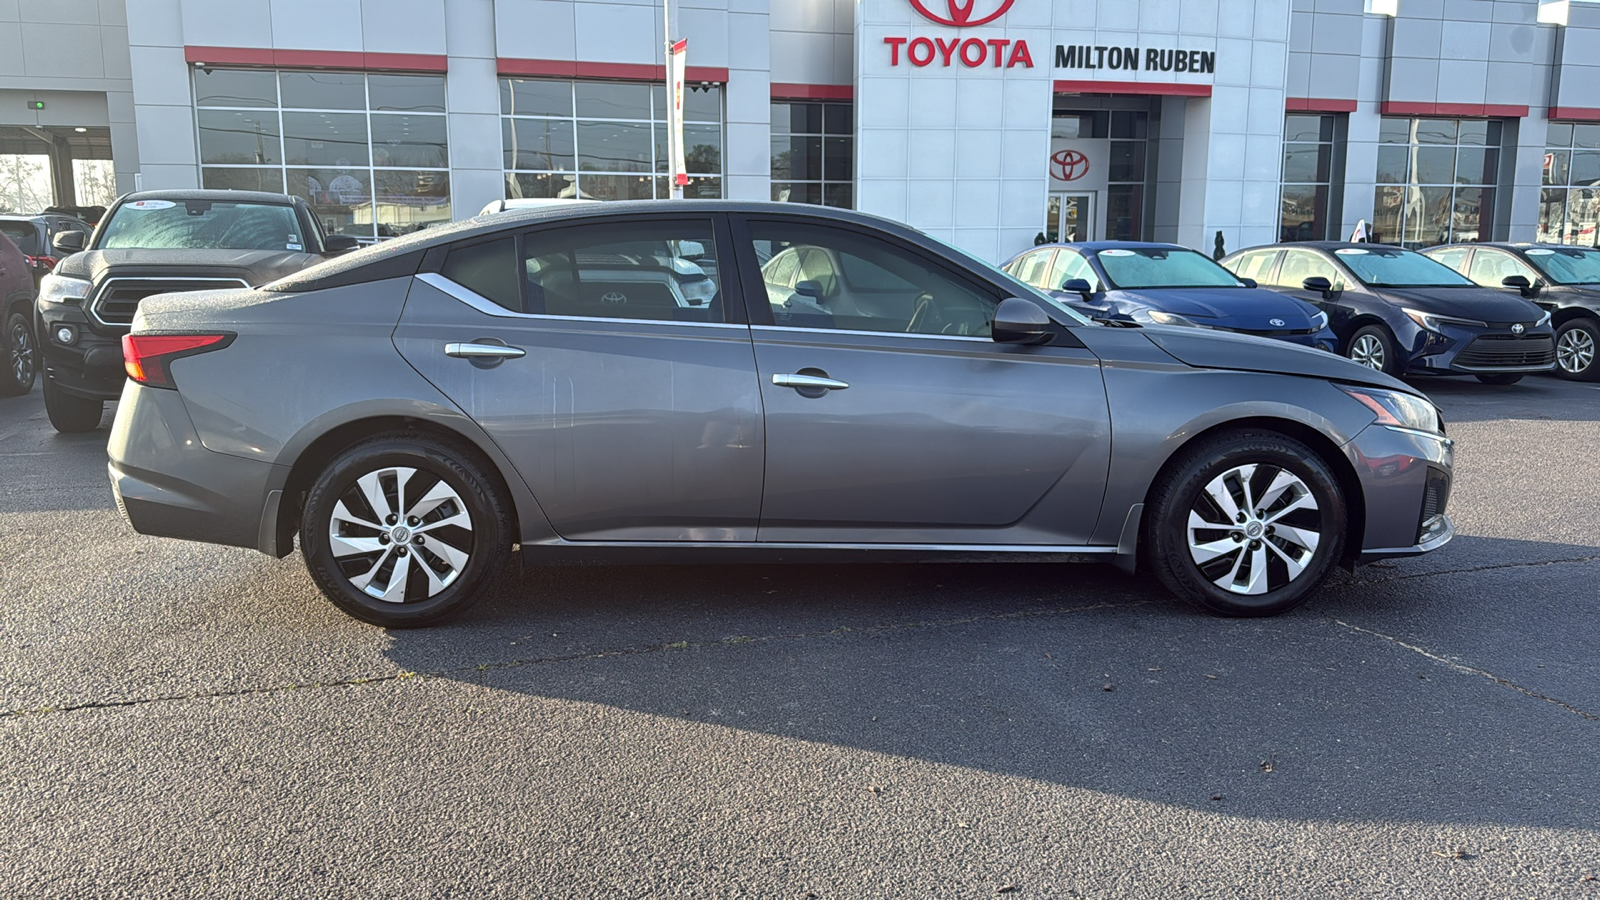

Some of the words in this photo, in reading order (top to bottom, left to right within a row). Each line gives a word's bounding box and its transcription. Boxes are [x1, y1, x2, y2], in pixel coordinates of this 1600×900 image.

[884, 36, 1034, 68] TOYOTA
[1054, 45, 1139, 70] MILTON
[1145, 48, 1215, 73] RUBEN
